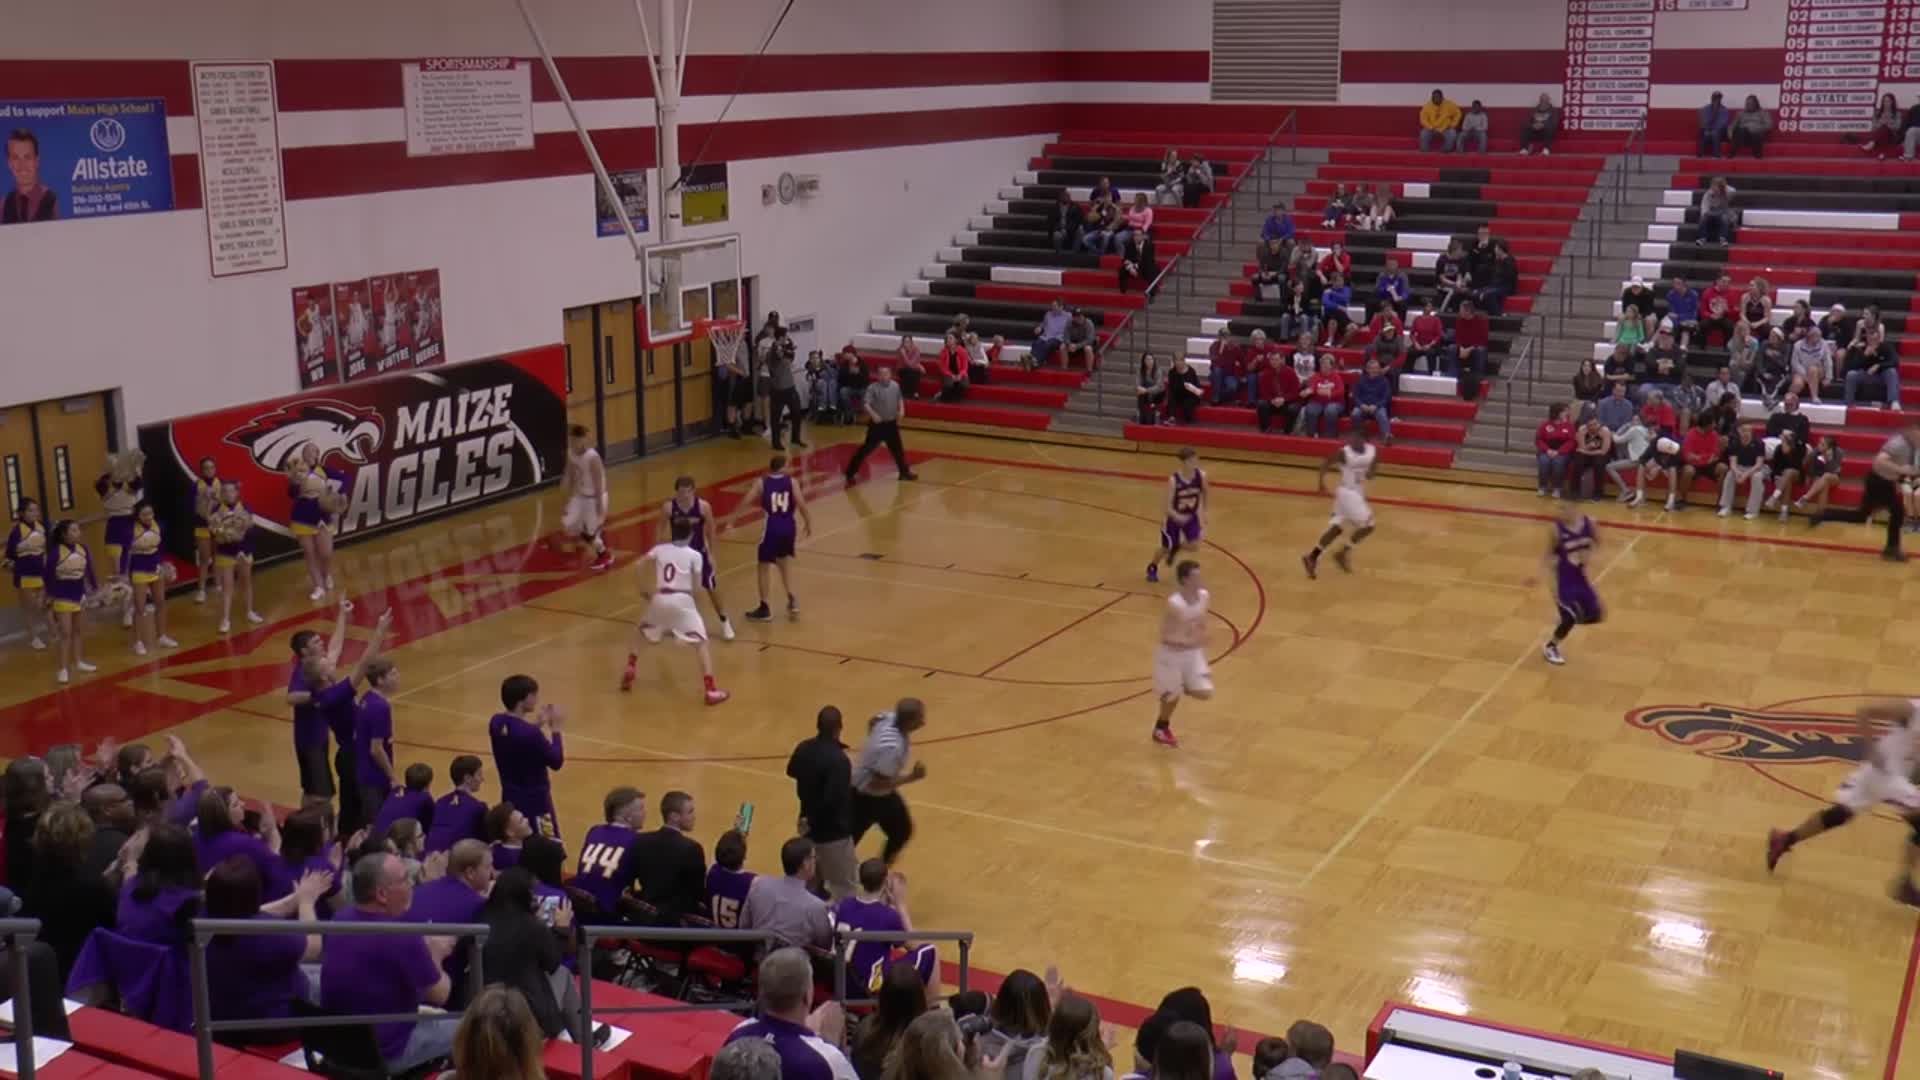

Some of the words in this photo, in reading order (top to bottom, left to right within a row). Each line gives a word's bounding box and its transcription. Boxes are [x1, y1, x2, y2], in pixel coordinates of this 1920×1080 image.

[1890, 7, 1910, 20] 13
[1888, 22, 1907, 34] 13
[1786, 38, 1806, 49] 05
[1886, 37, 1905, 49] 14
[1567, 54, 1582, 64] 11
[1885, 51, 1904, 63] 14
[425, 58, 510, 71] SPORTSMANSHIP
[1565, 67, 1582, 78] 12
[1883, 65, 1902, 77] 15
[1566, 80, 1582, 91] 12
[1565, 93, 1581, 104] 12
[1816, 94, 1848, 102] STATE
[12, 106, 25, 117] to
[26, 105, 66, 118] support
[67, 104, 97, 115] Maize
[1564, 106, 1580, 117] 13
[1780, 107, 1799, 118] 07
[1563, 119, 1579, 130] 13
[72, 156, 148, 181] Allstate
[393, 383, 514, 449] MAIZE
[331, 428, 518, 536] AGLES
[771, 491, 790, 513] 14
[663, 562, 676, 583] 0
[580, 842, 625, 879] 44
[711, 894, 739, 929] 15
